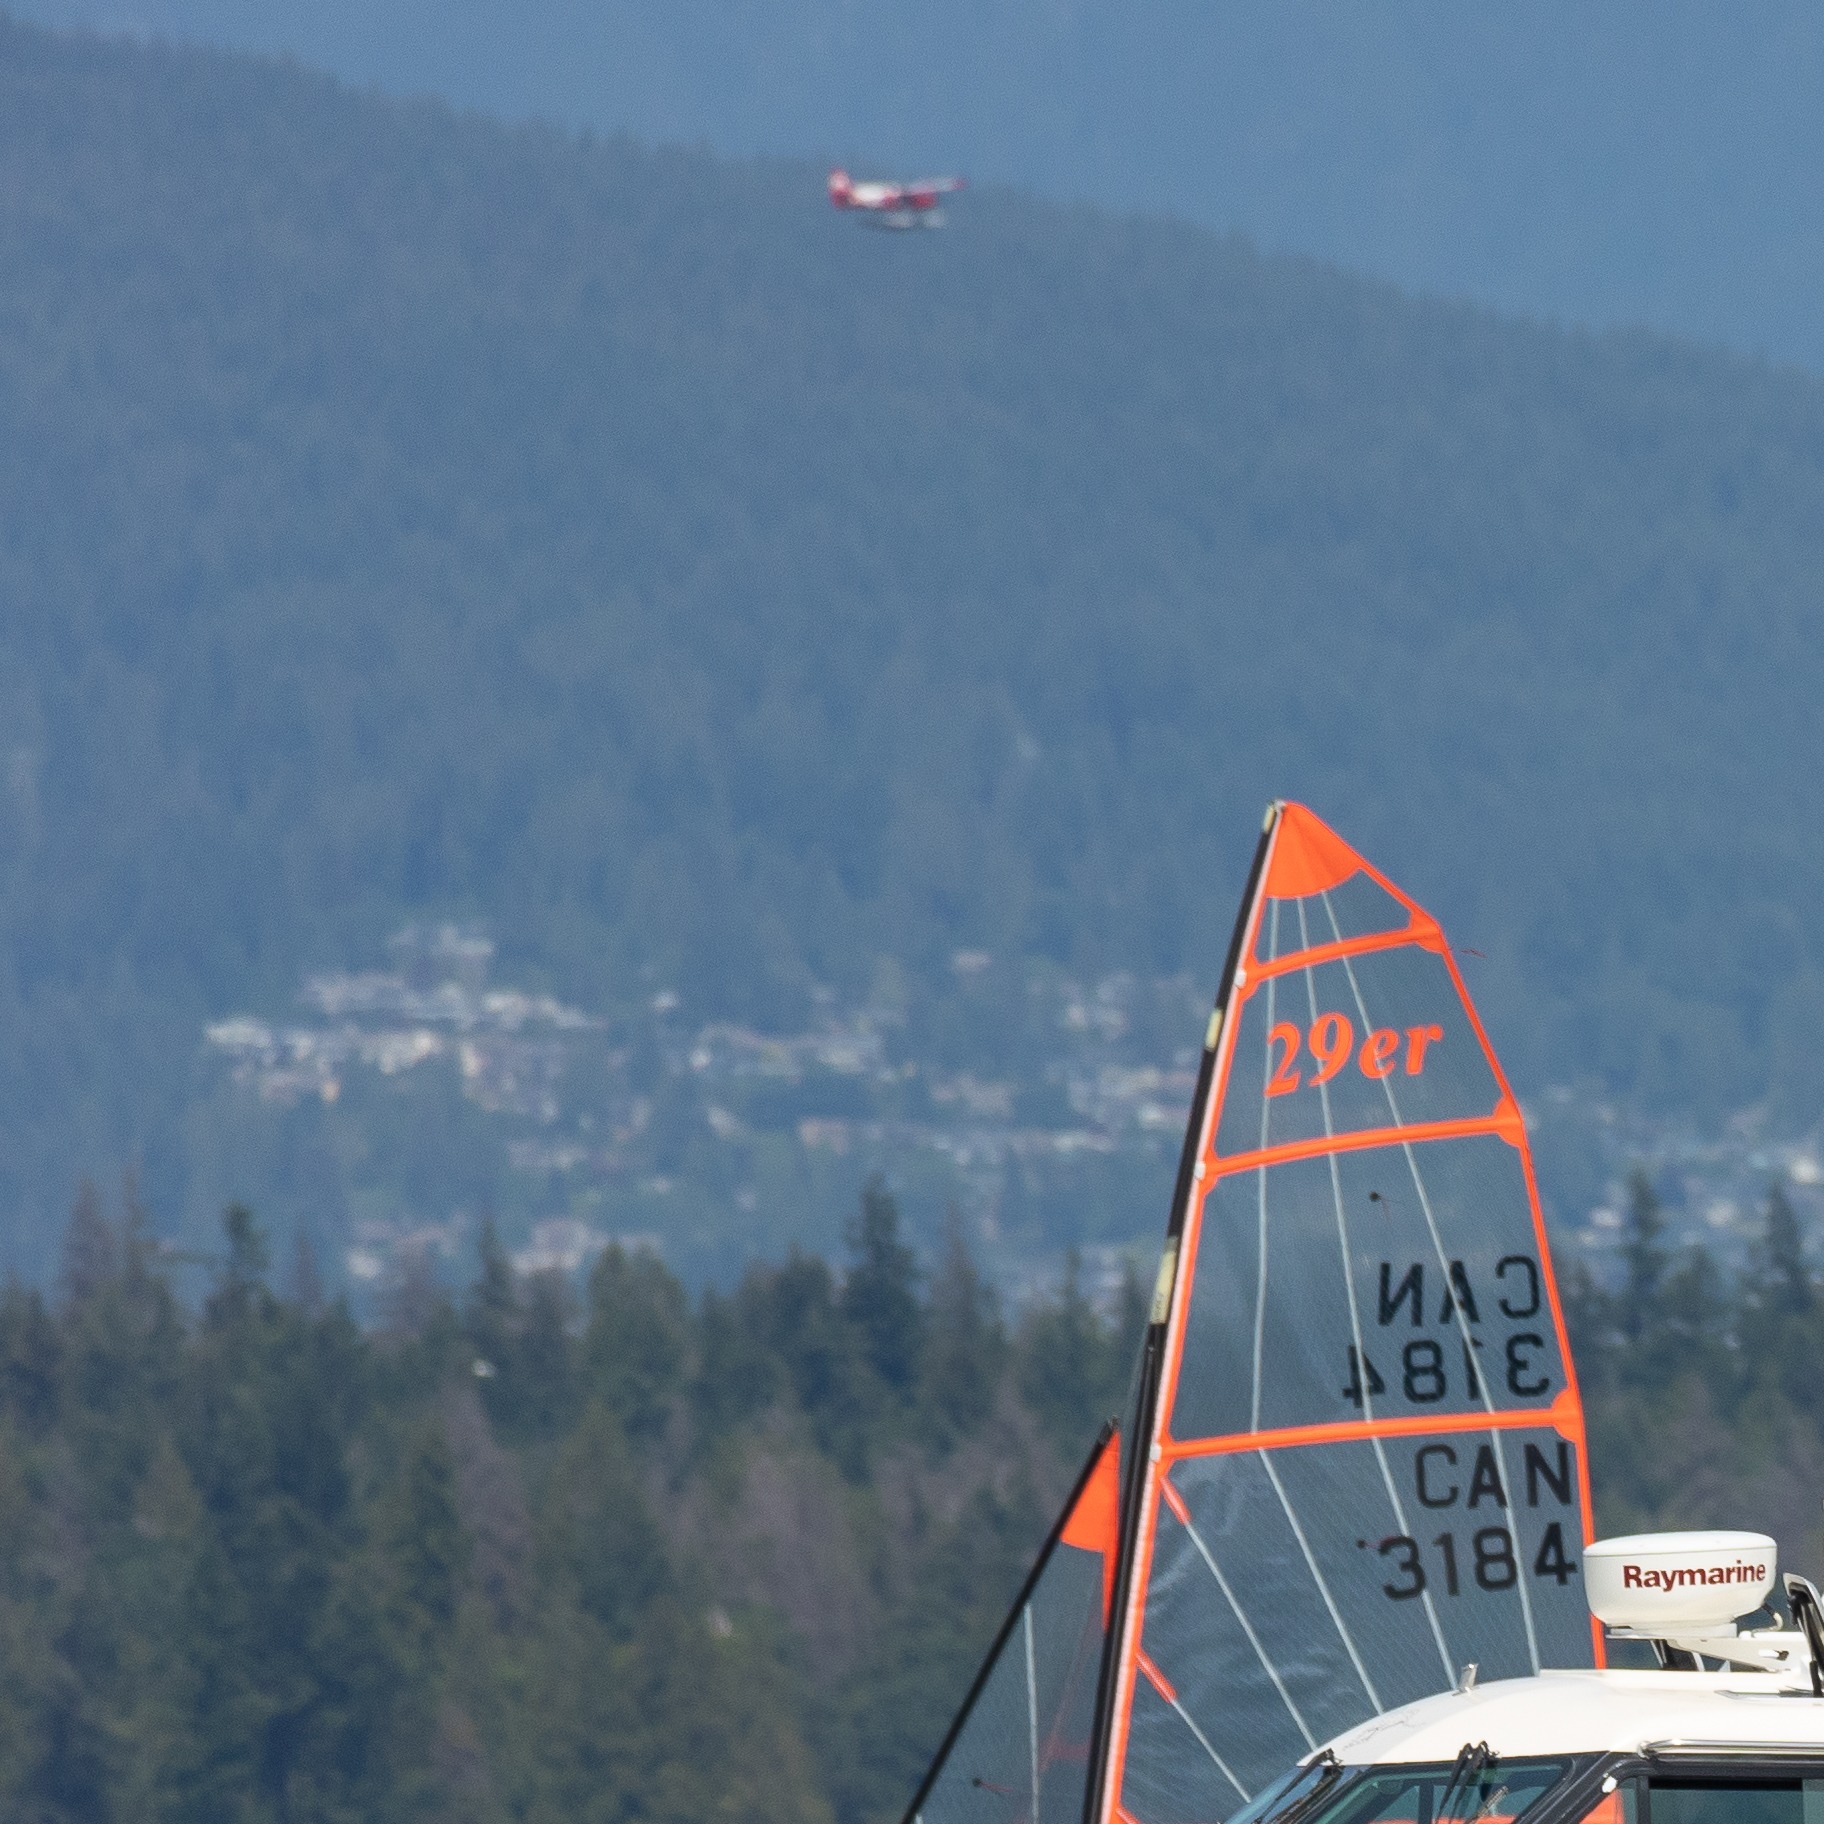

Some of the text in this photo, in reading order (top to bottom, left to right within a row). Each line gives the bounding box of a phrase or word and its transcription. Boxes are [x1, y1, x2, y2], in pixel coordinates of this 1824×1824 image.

[1264, 1012, 1444, 1097] 29er
[1416, 1441, 1574, 1510] CAN
[1378, 1521, 1577, 1600] 3184
[1623, 1560, 1766, 1592] Raymarine
